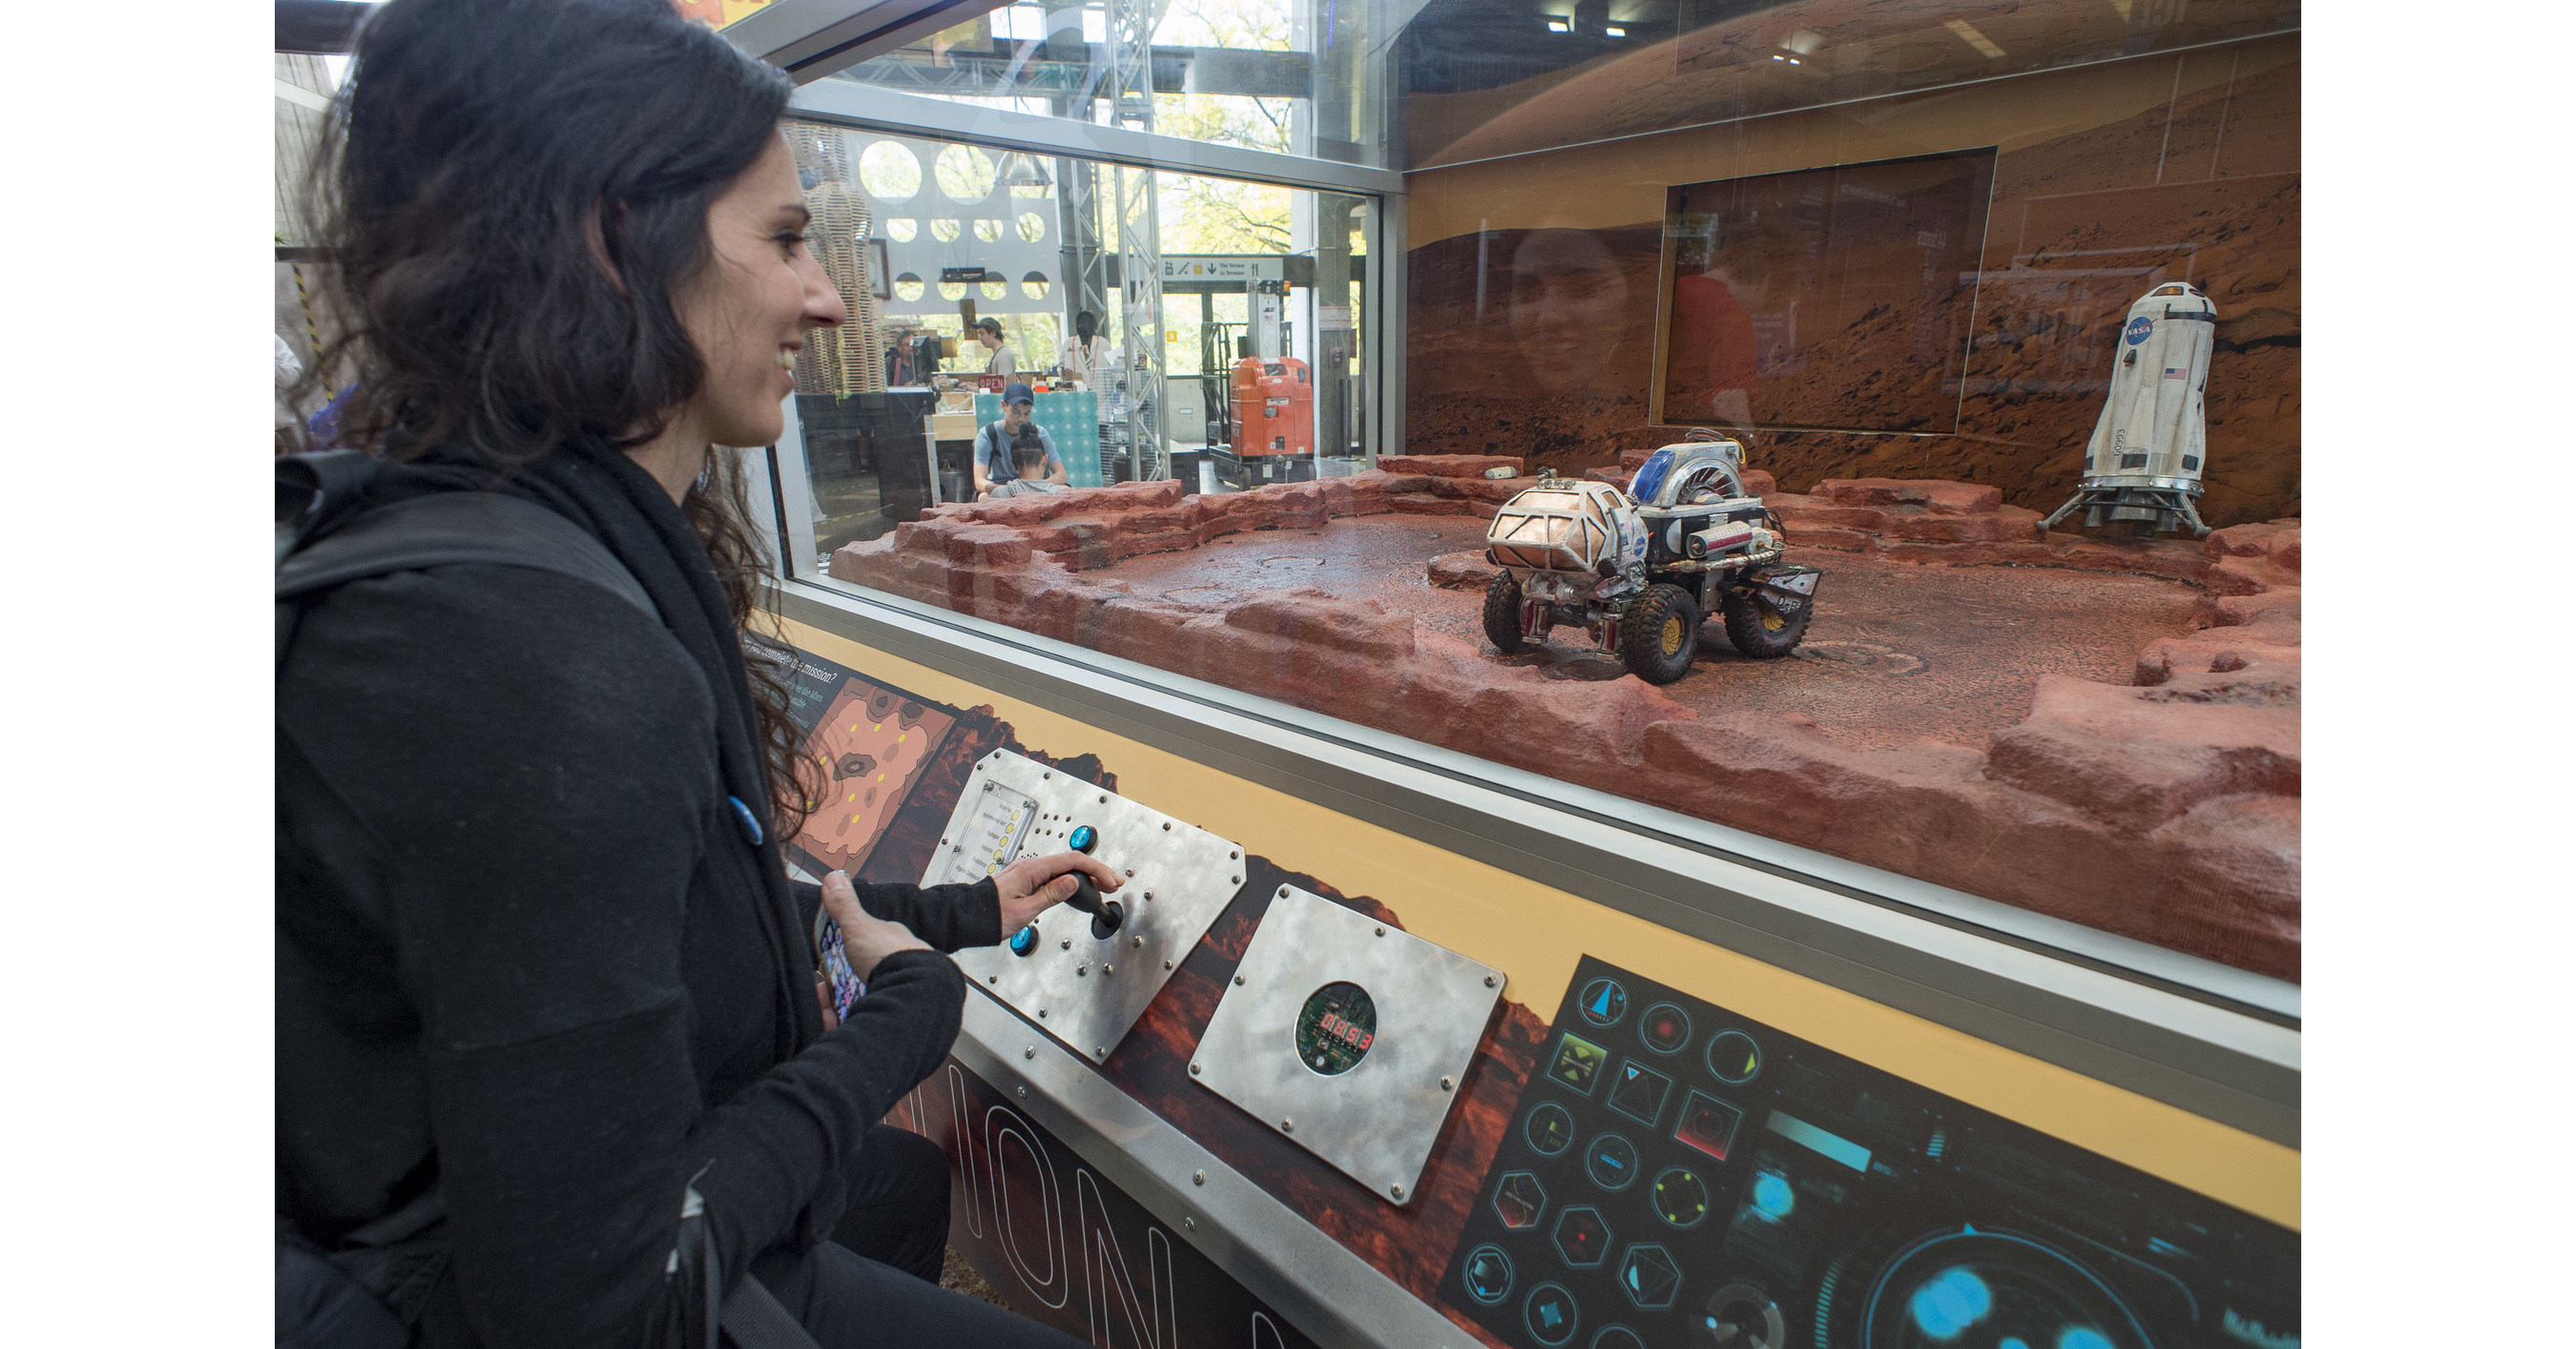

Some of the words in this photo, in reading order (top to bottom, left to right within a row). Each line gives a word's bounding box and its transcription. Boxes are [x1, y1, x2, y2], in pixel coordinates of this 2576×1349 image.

[2128, 326, 2151, 337] NASA
[980, 379, 1004, 389] OPEN
[762, 647, 793, 666] complete
[801, 663, 838, 684] mission?
